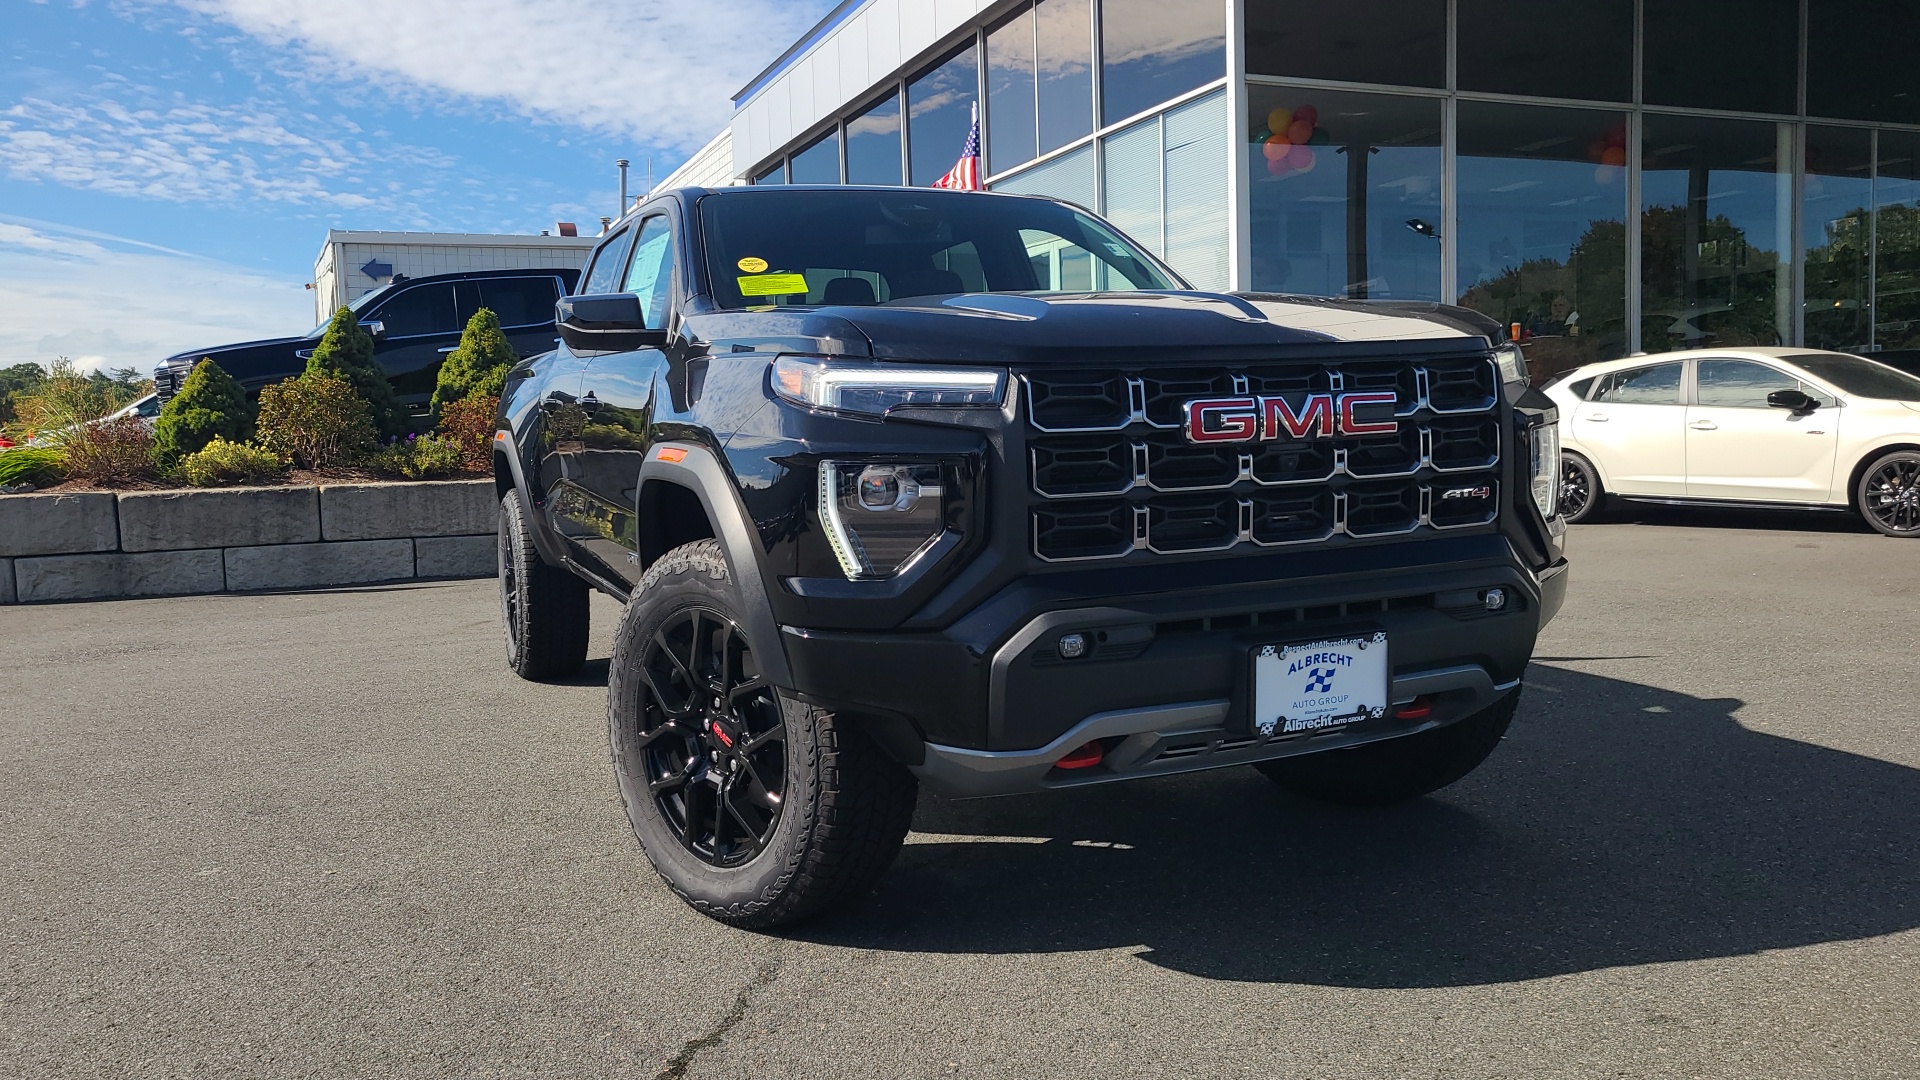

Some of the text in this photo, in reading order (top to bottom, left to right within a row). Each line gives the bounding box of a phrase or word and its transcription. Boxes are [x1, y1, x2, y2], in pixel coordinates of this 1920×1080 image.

[1181, 391, 1398, 443] GMC
[1442, 486, 1490, 499] AT4
[1284, 638, 1364, 653] RespectAtAlbrecht.com
[1288, 652, 1353, 675] ALBRECHT
[1292, 694, 1349, 709] AUTO GROUP
[1284, 715, 1333, 732] Albrecht
[1348, 715, 1366, 723] GROUP
[712, 722, 733, 748] GMC
